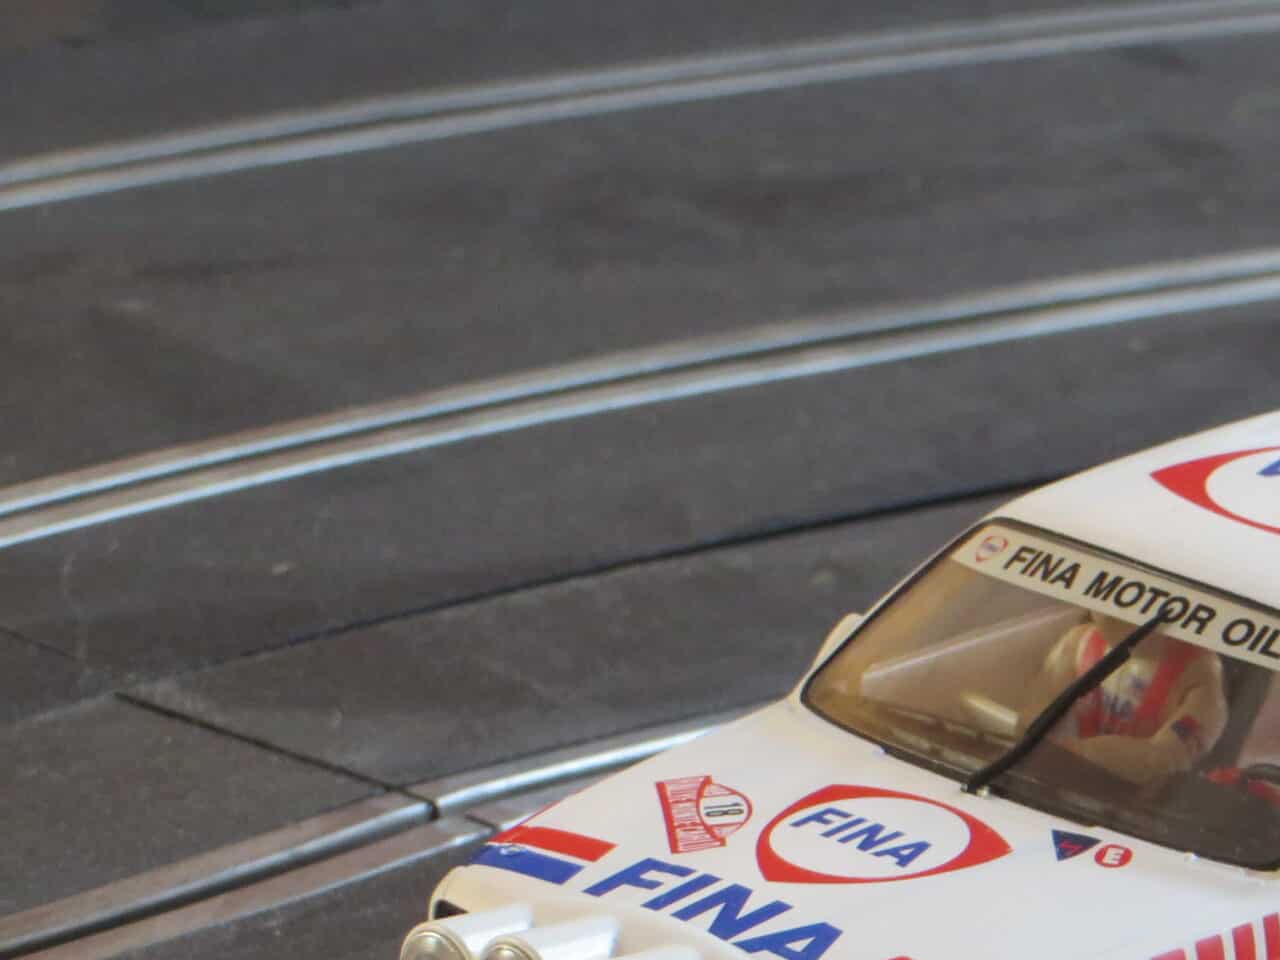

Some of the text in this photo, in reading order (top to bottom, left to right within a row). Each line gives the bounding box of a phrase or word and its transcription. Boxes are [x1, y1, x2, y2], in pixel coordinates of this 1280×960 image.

[1002, 545, 1081, 590] FINA
[1083, 571, 1217, 635] MOTOR
[703, 801, 745, 818] 18
[788, 807, 932, 868] FINA
